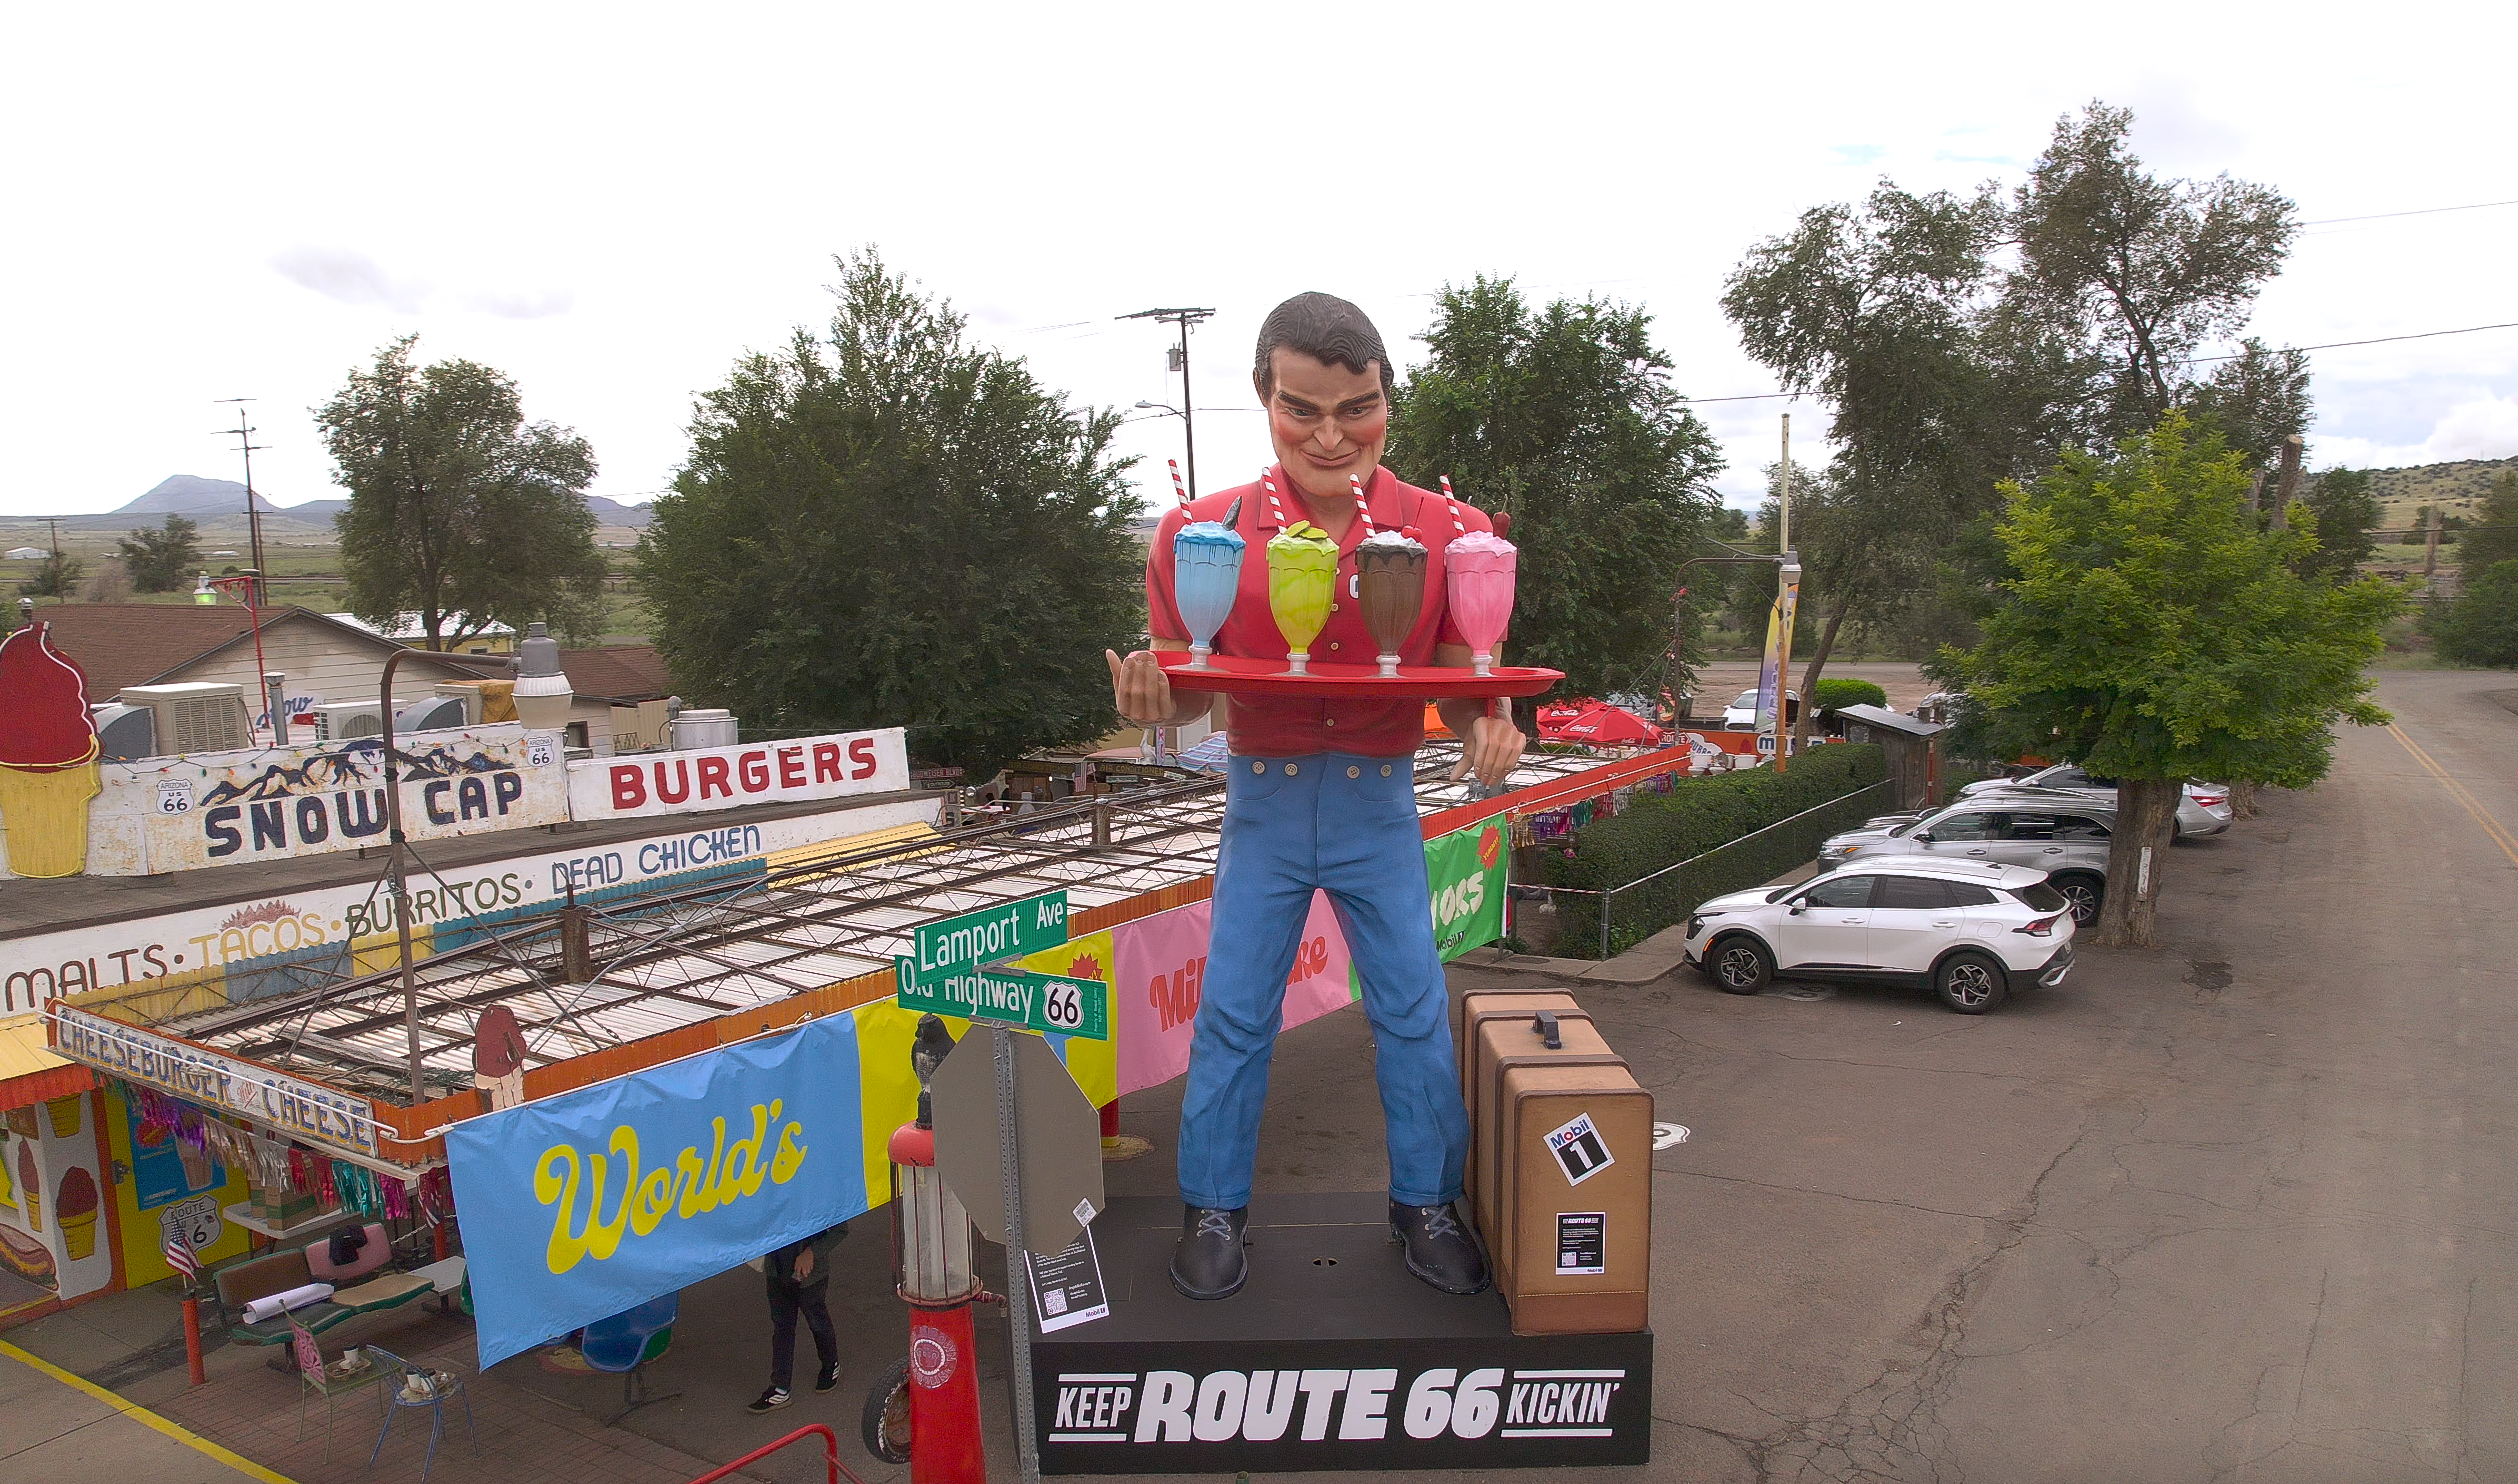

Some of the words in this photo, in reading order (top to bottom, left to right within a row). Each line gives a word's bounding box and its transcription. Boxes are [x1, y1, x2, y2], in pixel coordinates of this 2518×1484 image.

[533, 752, 550, 765] 66
[610, 737, 877, 811] BURGERS
[1115, 765, 1164, 775] CONDITIONED
[163, 798, 188, 812] 66
[205, 788, 389, 857] SNOW
[424, 772, 523, 825] CAP
[6, 943, 168, 1012] MALTS
[188, 912, 325, 964] TACOS
[345, 873, 521, 938] BURRITOS
[552, 851, 623, 895] DEAD
[639, 825, 761, 874] CHICKEN
[919, 913, 1021, 973] Lamport
[1036, 900, 1063, 932] Ave
[945, 970, 1034, 1024] Highway
[1047, 984, 1079, 1025] 66
[58, 1008, 235, 1108] CHEESEBURGER
[262, 1079, 372, 1151] CHEESE
[1550, 1119, 1590, 1149] Mobil
[1569, 1140, 1594, 1170] 1
[534, 1098, 808, 1275] World's
[1085, 1308, 1100, 1318] Mobil
[1055, 1387, 1132, 1429] KEEP
[1134, 1368, 1398, 1443] ROUTE
[1403, 1368, 1505, 1440] 66
[1504, 1382, 1621, 1424] KICKIN'
